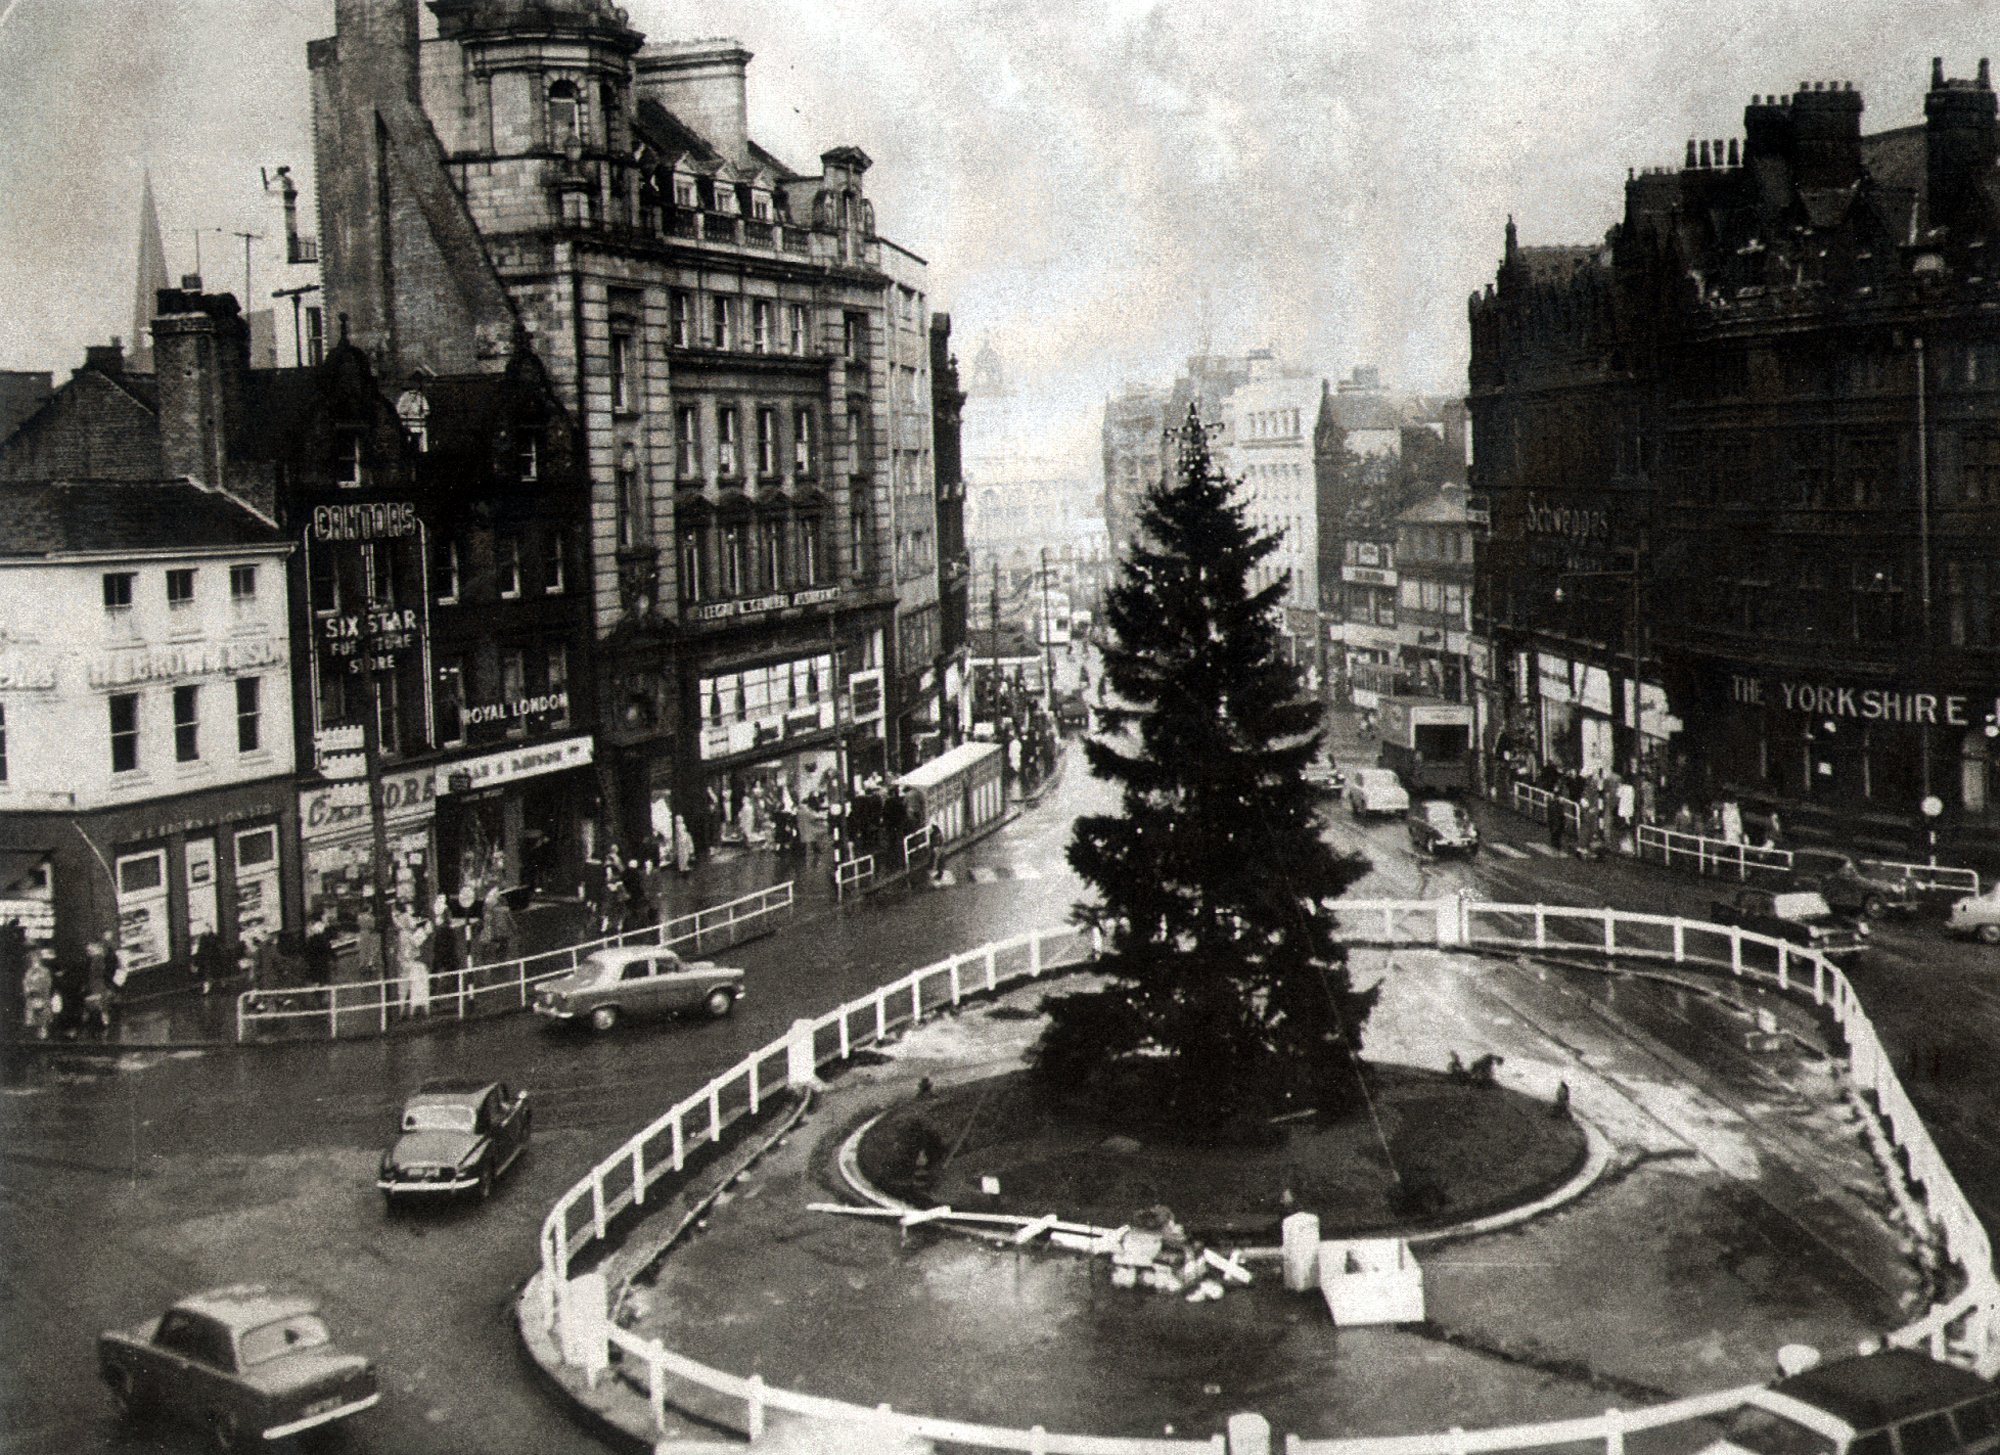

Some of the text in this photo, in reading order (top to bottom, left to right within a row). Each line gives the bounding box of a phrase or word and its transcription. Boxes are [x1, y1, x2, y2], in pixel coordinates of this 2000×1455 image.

[314, 502, 415, 541] CANTORS
[325, 609, 416, 638] SIX STAR
[331, 633, 411, 656] FUTURE
[460, 691, 569, 726] ROYAL LONDON
[1733, 675, 1765, 706] THE
[1781, 682, 1969, 726] YORKSHIRE
